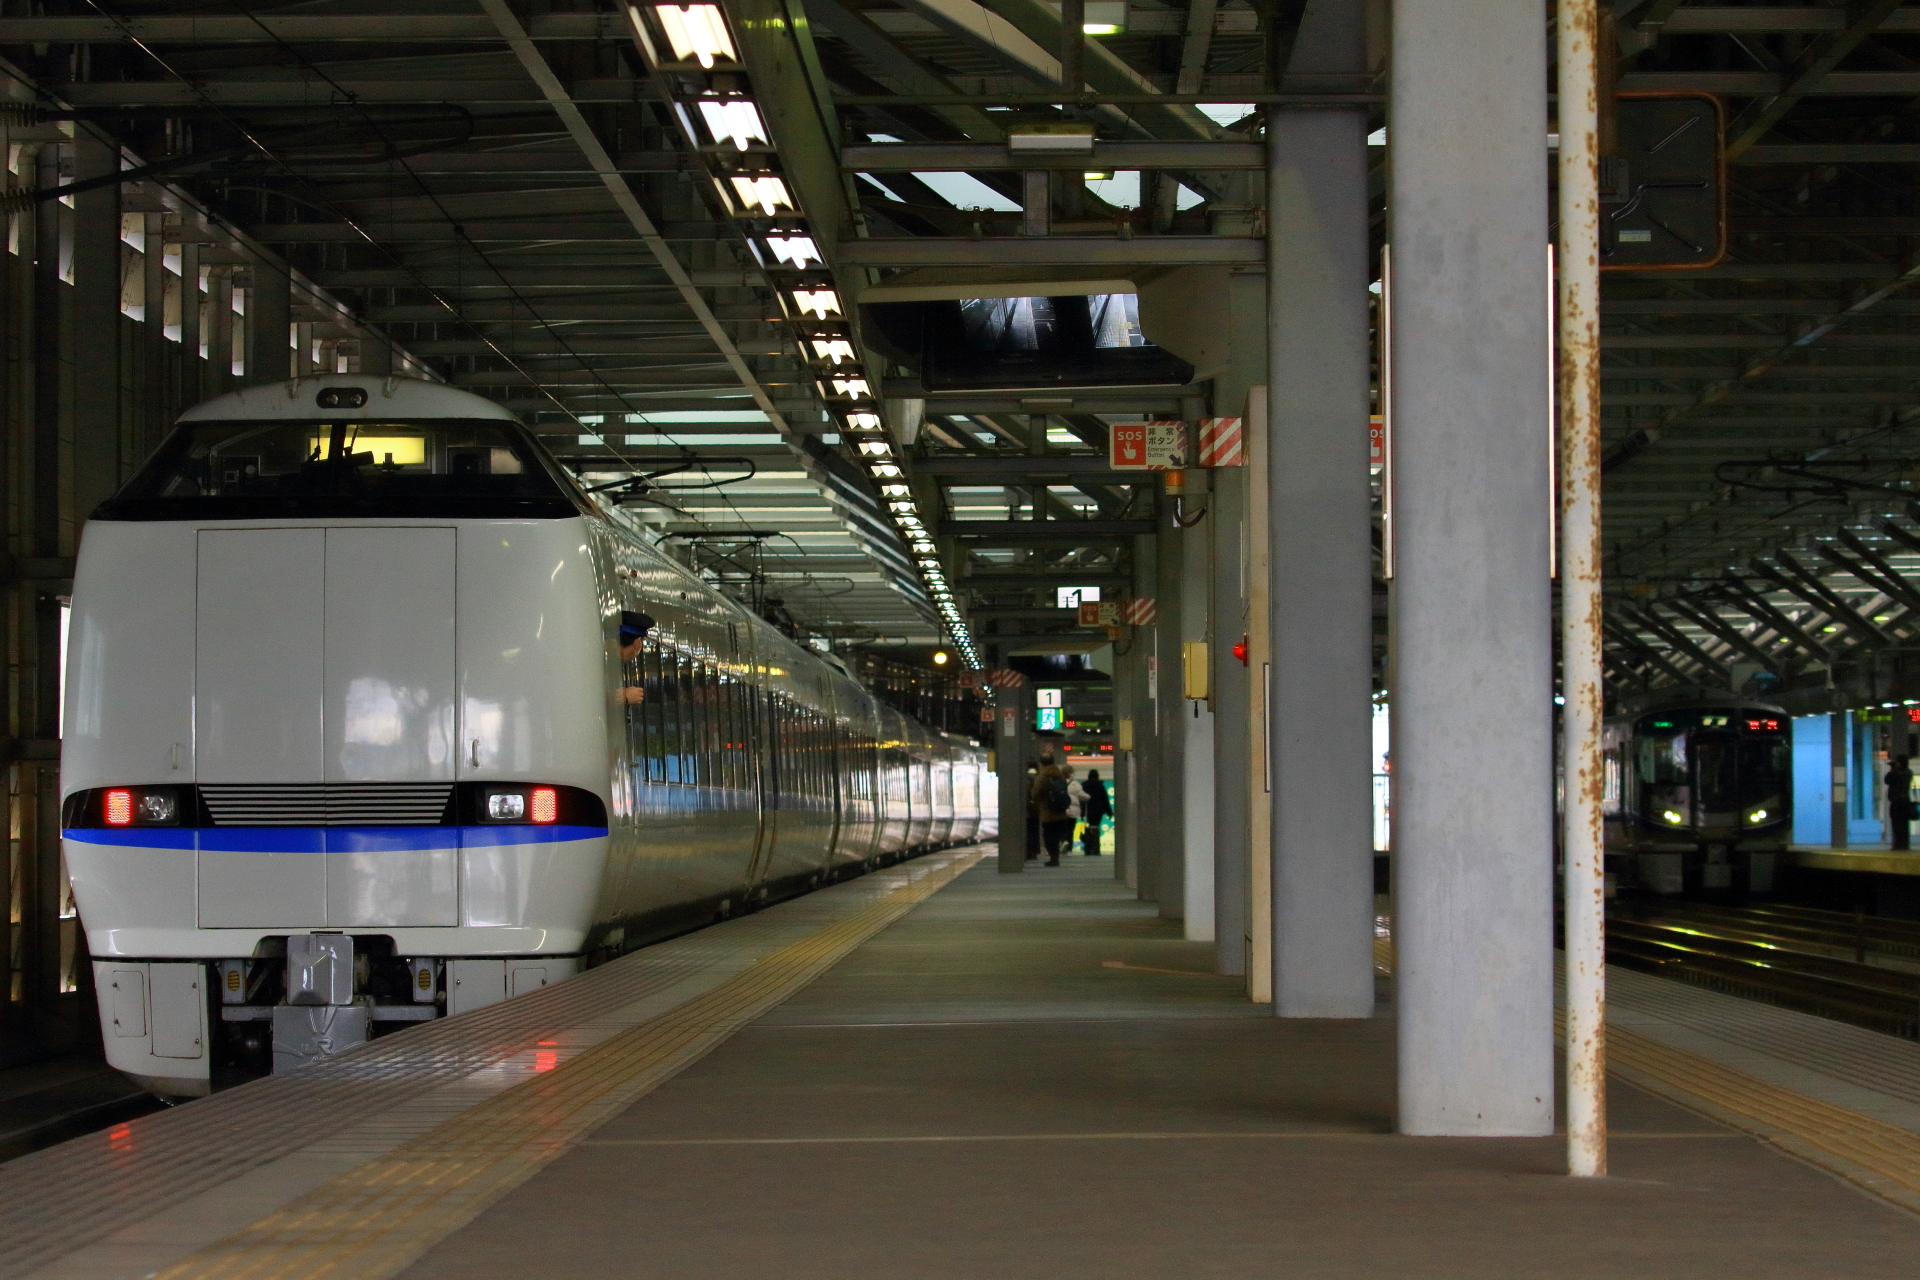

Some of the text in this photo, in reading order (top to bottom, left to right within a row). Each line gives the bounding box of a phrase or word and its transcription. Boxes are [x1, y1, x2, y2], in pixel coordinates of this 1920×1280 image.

[1117, 431, 1143, 441] SOS
[1148, 427, 1174, 436] 非常
[1370, 429, 1385, 438] OS
[1148, 437, 1174, 445] ボタン
[1046, 692, 1052, 705] 1
